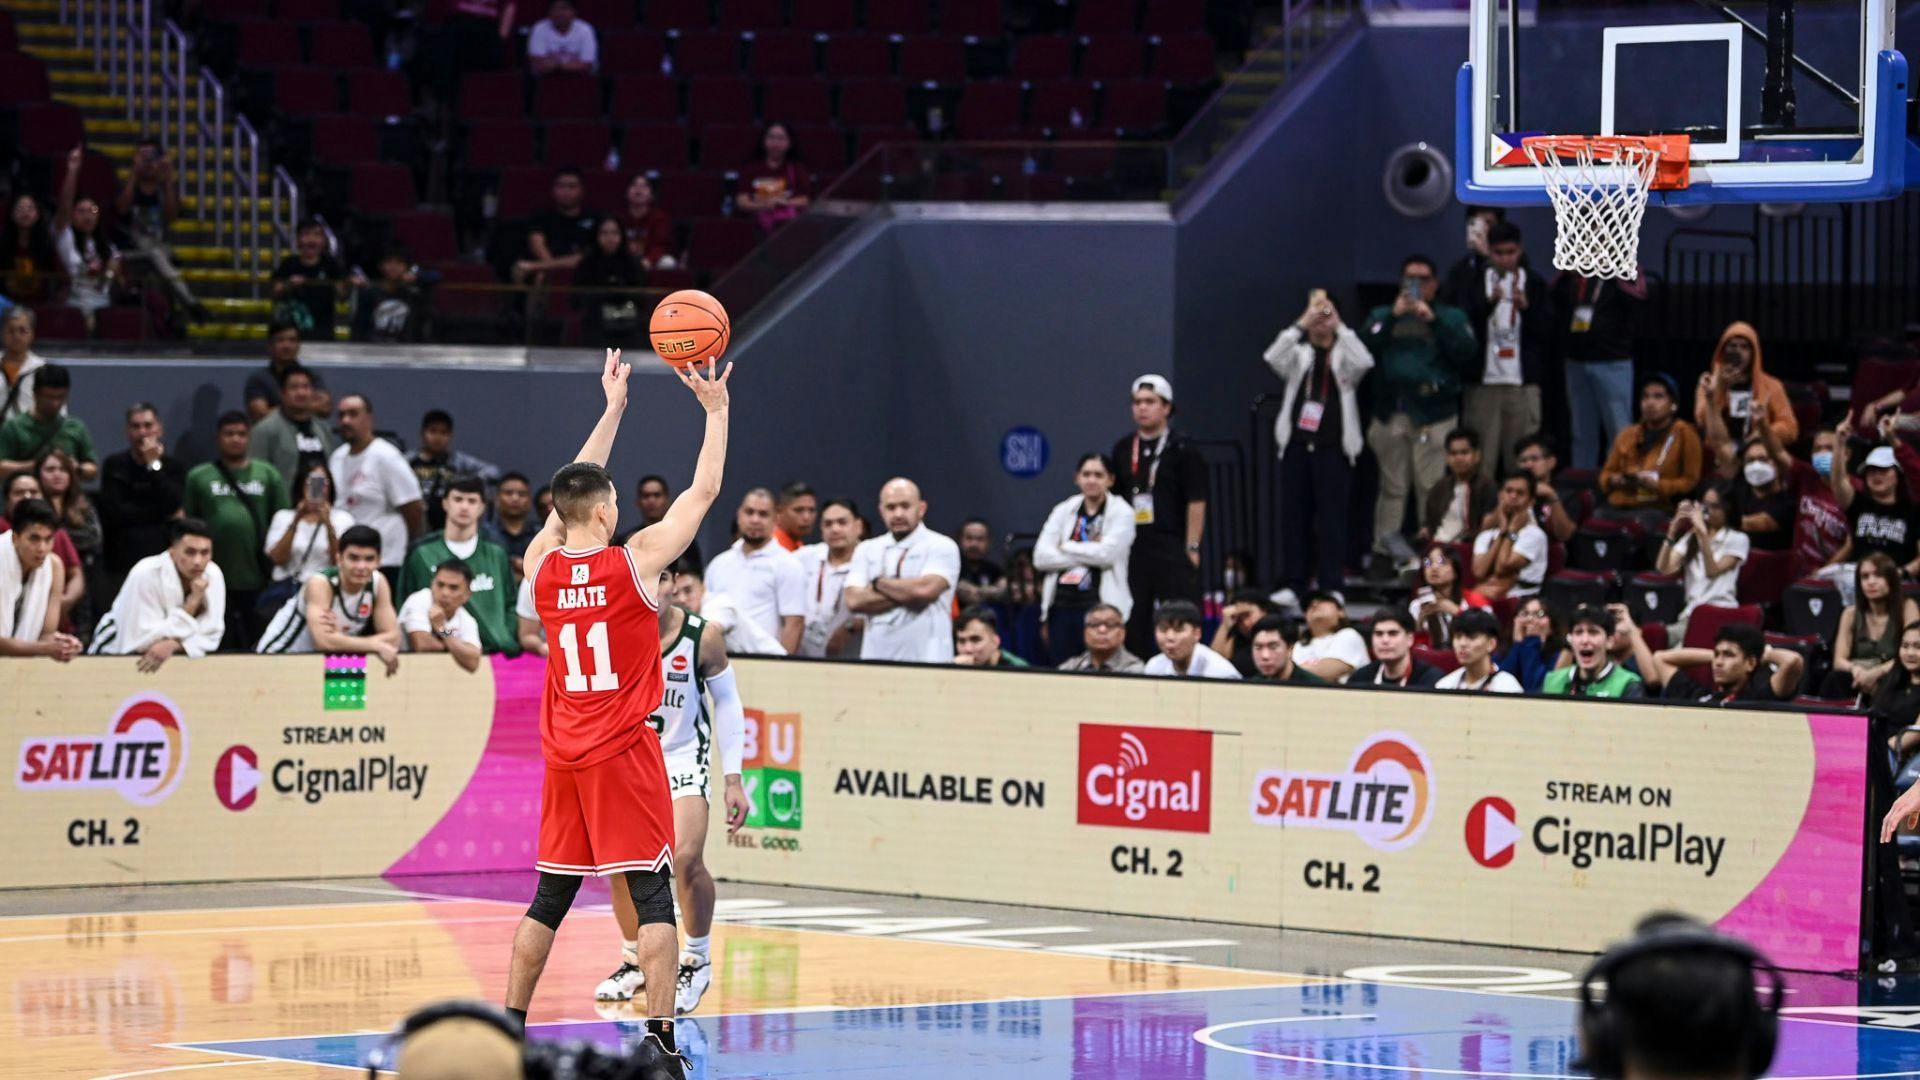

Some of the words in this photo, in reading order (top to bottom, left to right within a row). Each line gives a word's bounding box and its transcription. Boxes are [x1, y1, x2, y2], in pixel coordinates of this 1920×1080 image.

[657, 339, 696, 353] ELITE
[557, 585, 607, 610] ABATE
[558, 621, 620, 692] 11
[283, 727, 353, 744] STREAM
[359, 726, 386, 743] ON
[21, 742, 164, 782] SATLITE
[271, 755, 429, 803] CignalPlay
[834, 768, 993, 804] AVAILABLE
[1001, 779, 1045, 808] ON
[1085, 763, 1200, 821] Cignal
[1256, 776, 1410, 824] SATLITE
[1546, 781, 1632, 805] STREAM
[1639, 786, 1671, 807] ON
[67, 819, 115, 846] CH.
[123, 818, 140, 845] 2
[1532, 816, 1726, 877] CignalPlay
[1110, 846, 1158, 876] CH.
[1166, 850, 1184, 876] 2
[1303, 860, 1354, 891] CH.
[1362, 865, 1381, 892] 2
